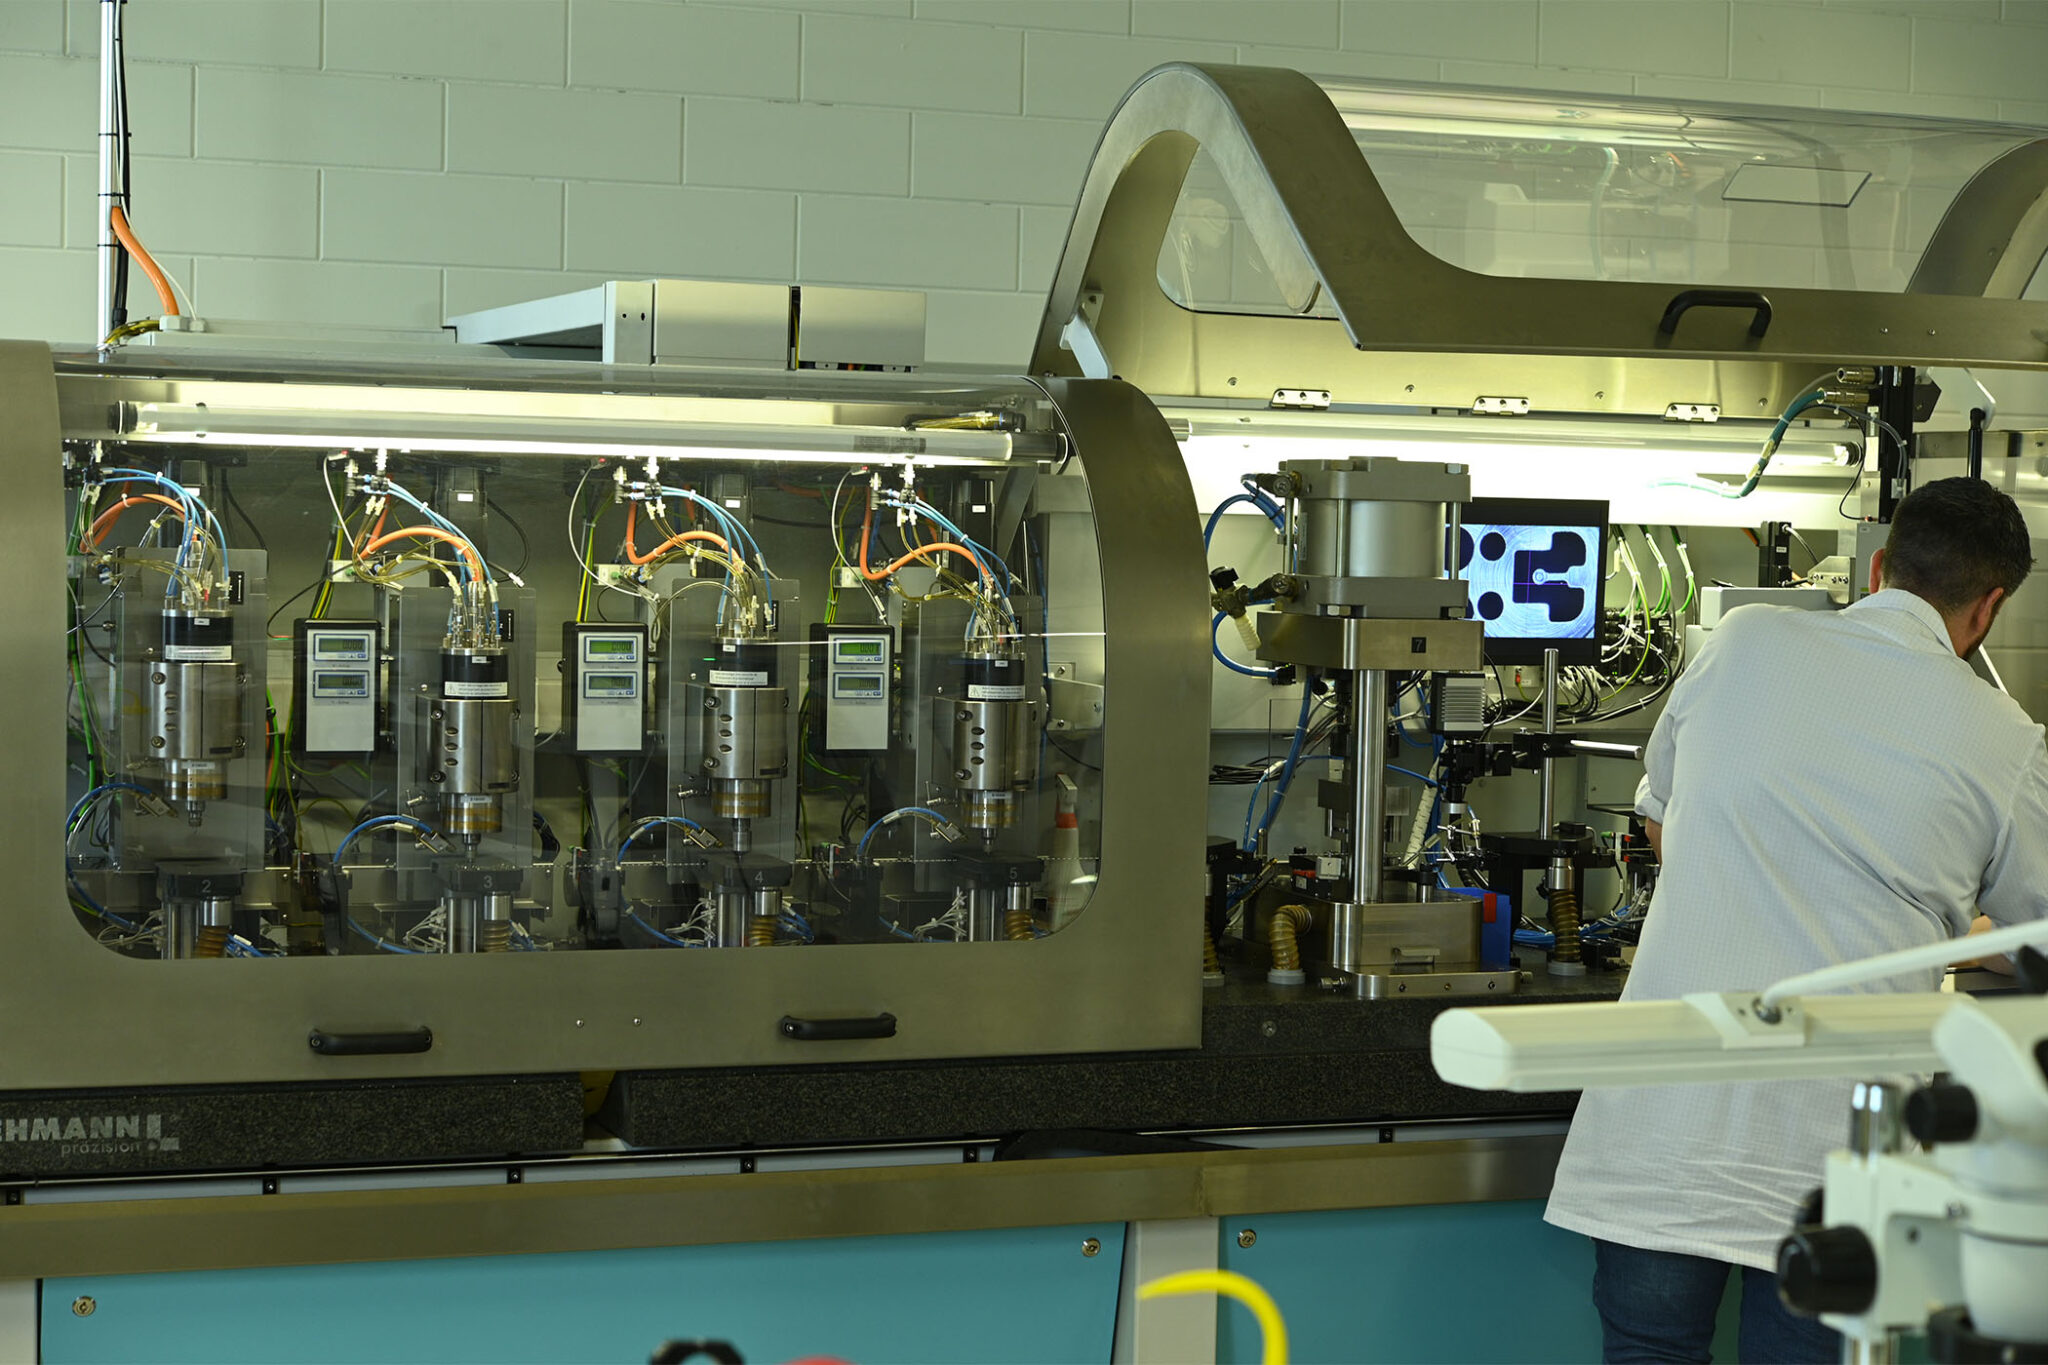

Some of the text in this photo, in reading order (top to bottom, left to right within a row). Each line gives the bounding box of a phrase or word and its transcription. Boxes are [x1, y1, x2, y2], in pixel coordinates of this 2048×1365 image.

[1414, 638, 1423, 652] 7
[754, 870, 764, 884] 4
[1009, 866, 1018, 880] 5
[201, 879, 212, 893] 2
[483, 874, 493, 889] 3
[0, 1114, 140, 1141] HMANN
